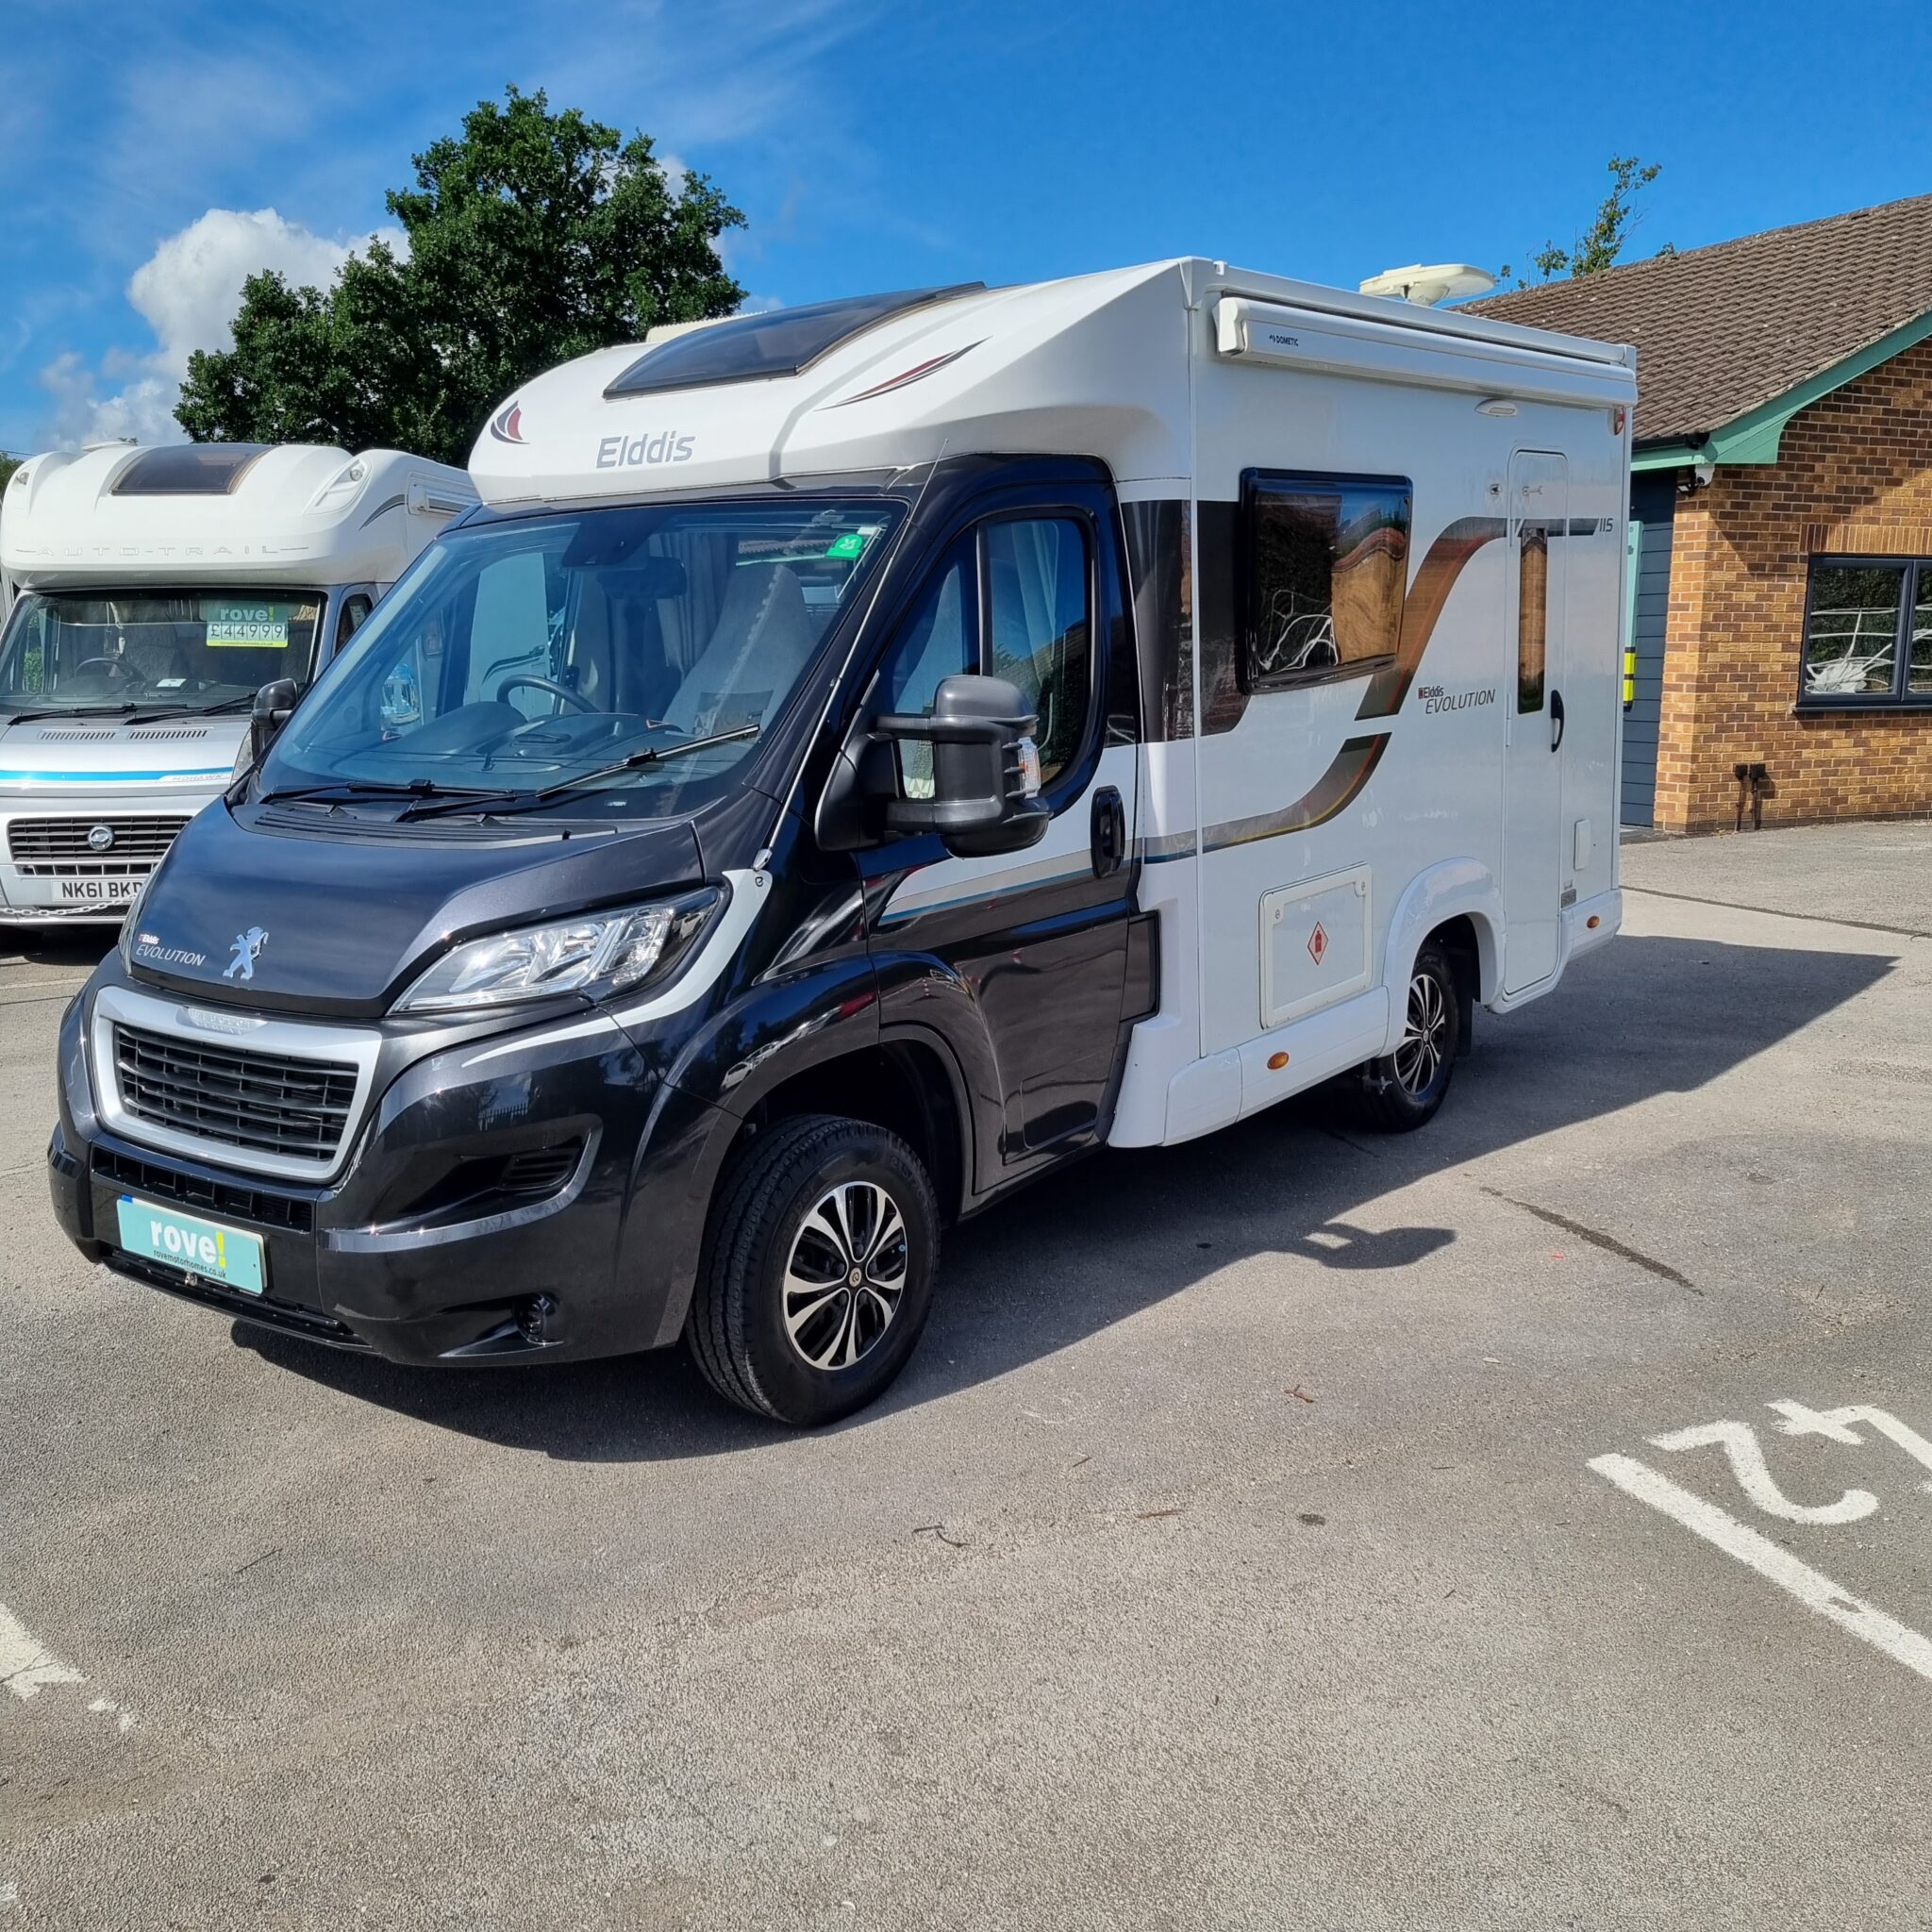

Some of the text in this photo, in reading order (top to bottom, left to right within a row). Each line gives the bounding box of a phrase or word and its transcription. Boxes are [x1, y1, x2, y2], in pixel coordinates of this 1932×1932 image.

[595, 430, 696, 469] Elddis
[1599, 517, 1614, 533] 115
[220, 606, 275, 622] rove!
[210, 624, 284, 639] £44999
[1424, 685, 1444, 699] Elddis
[1425, 689, 1496, 715] EVOLUTION
[61, 882, 103, 898] NK61
[136, 944, 207, 966] EVOLUTION
[150, 1220, 226, 1268] rove!
[153, 1249, 227, 1279] rovemotorhomes.co.uk
